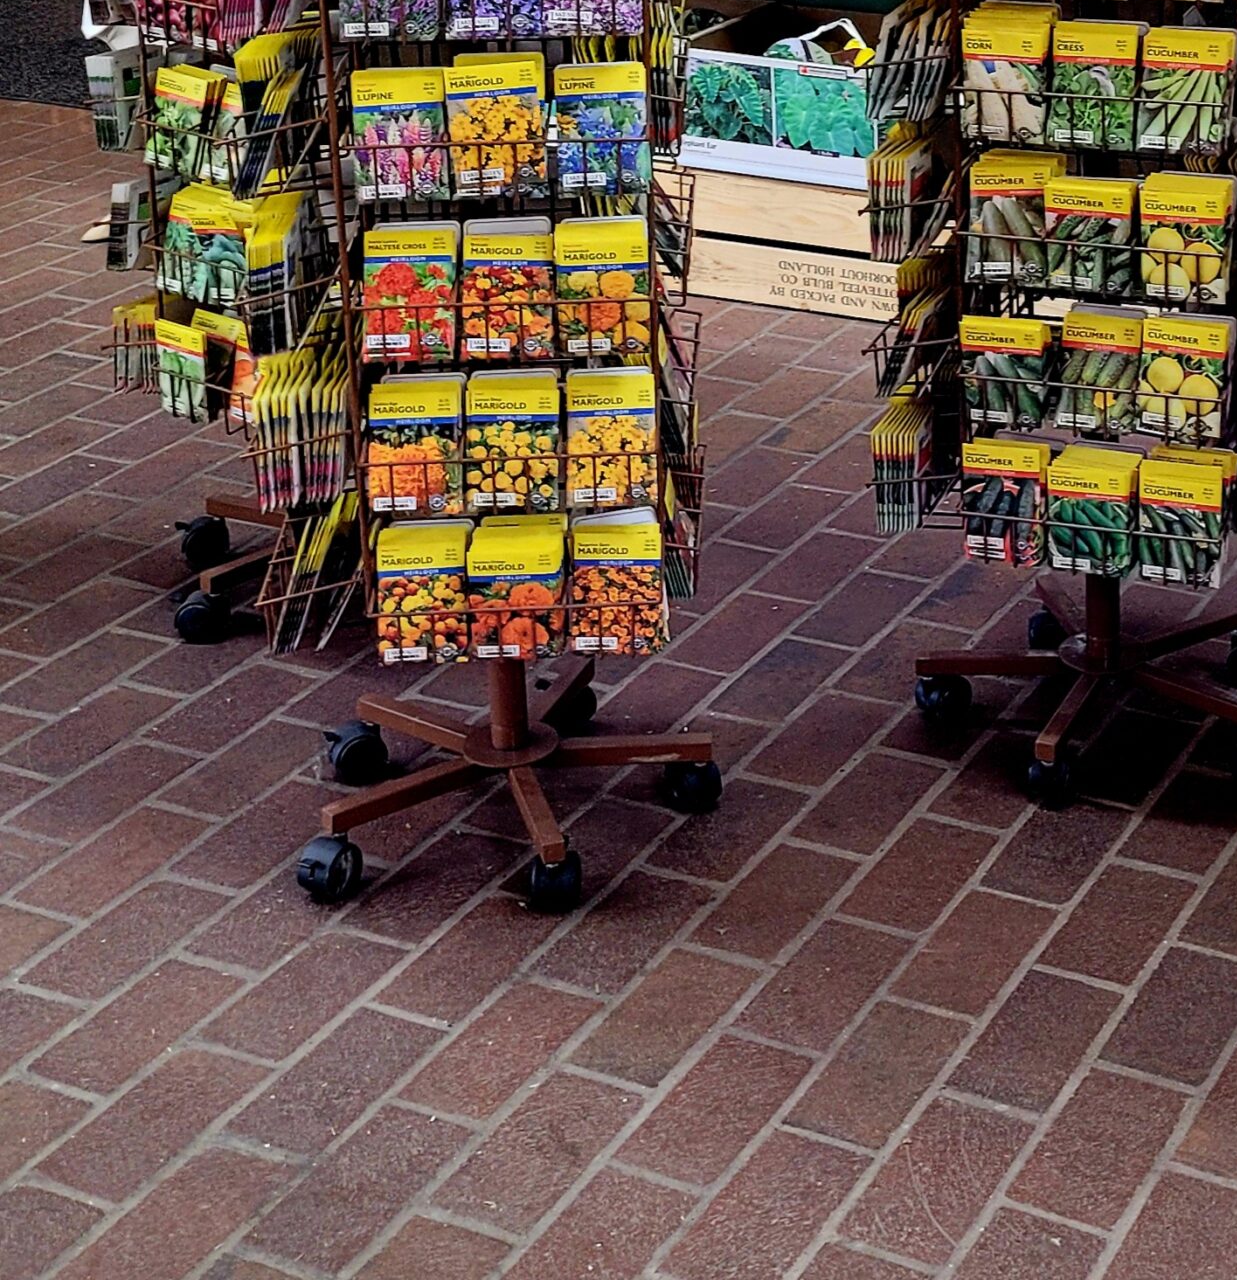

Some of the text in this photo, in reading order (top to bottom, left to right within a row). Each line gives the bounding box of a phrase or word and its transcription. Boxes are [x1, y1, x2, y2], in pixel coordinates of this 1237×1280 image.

[966, 41, 993, 50] CORN
[1057, 43, 1085, 52] CRESS
[1147, 48, 1199, 59] CUCUMBER
[450, 77, 504, 89] MARIGOLD
[559, 81, 596, 90] LUPINE
[357, 92, 394, 101] LUPINE
[705, 141, 717, 150] Ear
[975, 177, 1024, 185] CUCUMBER
[1052, 197, 1104, 208] CUCUMBER
[1145, 202, 1197, 213] CUCUMBER
[470, 247, 523, 256] MARIGOLD
[564, 252, 617, 261] MARIGOLD
[778, 260, 898, 281] OORHOUT HOLLAND
[780, 274, 898, 299] OTTEVEEL BULB CO.
[769, 285, 898, 313] OWN AND PACKED BY
[966, 335, 1016, 344] CUCUMBER
[1066, 329, 1115, 341] CUCUMBER
[1148, 331, 1199, 345] CUCUMBER
[572, 397, 623, 406] MARIGOLD
[374, 405, 426, 414] MARIGOLD
[474, 402, 527, 411] MARIGOLD
[965, 456, 1013, 466] CUCUMBER
[1050, 478, 1099, 489] CUCUMBER
[1144, 487, 1194, 499] CUCUMBER
[578, 546, 629, 555] MARIGOLD
[381, 556, 434, 566] MARIGOLD
[473, 563, 525, 572] MARIGOLD
